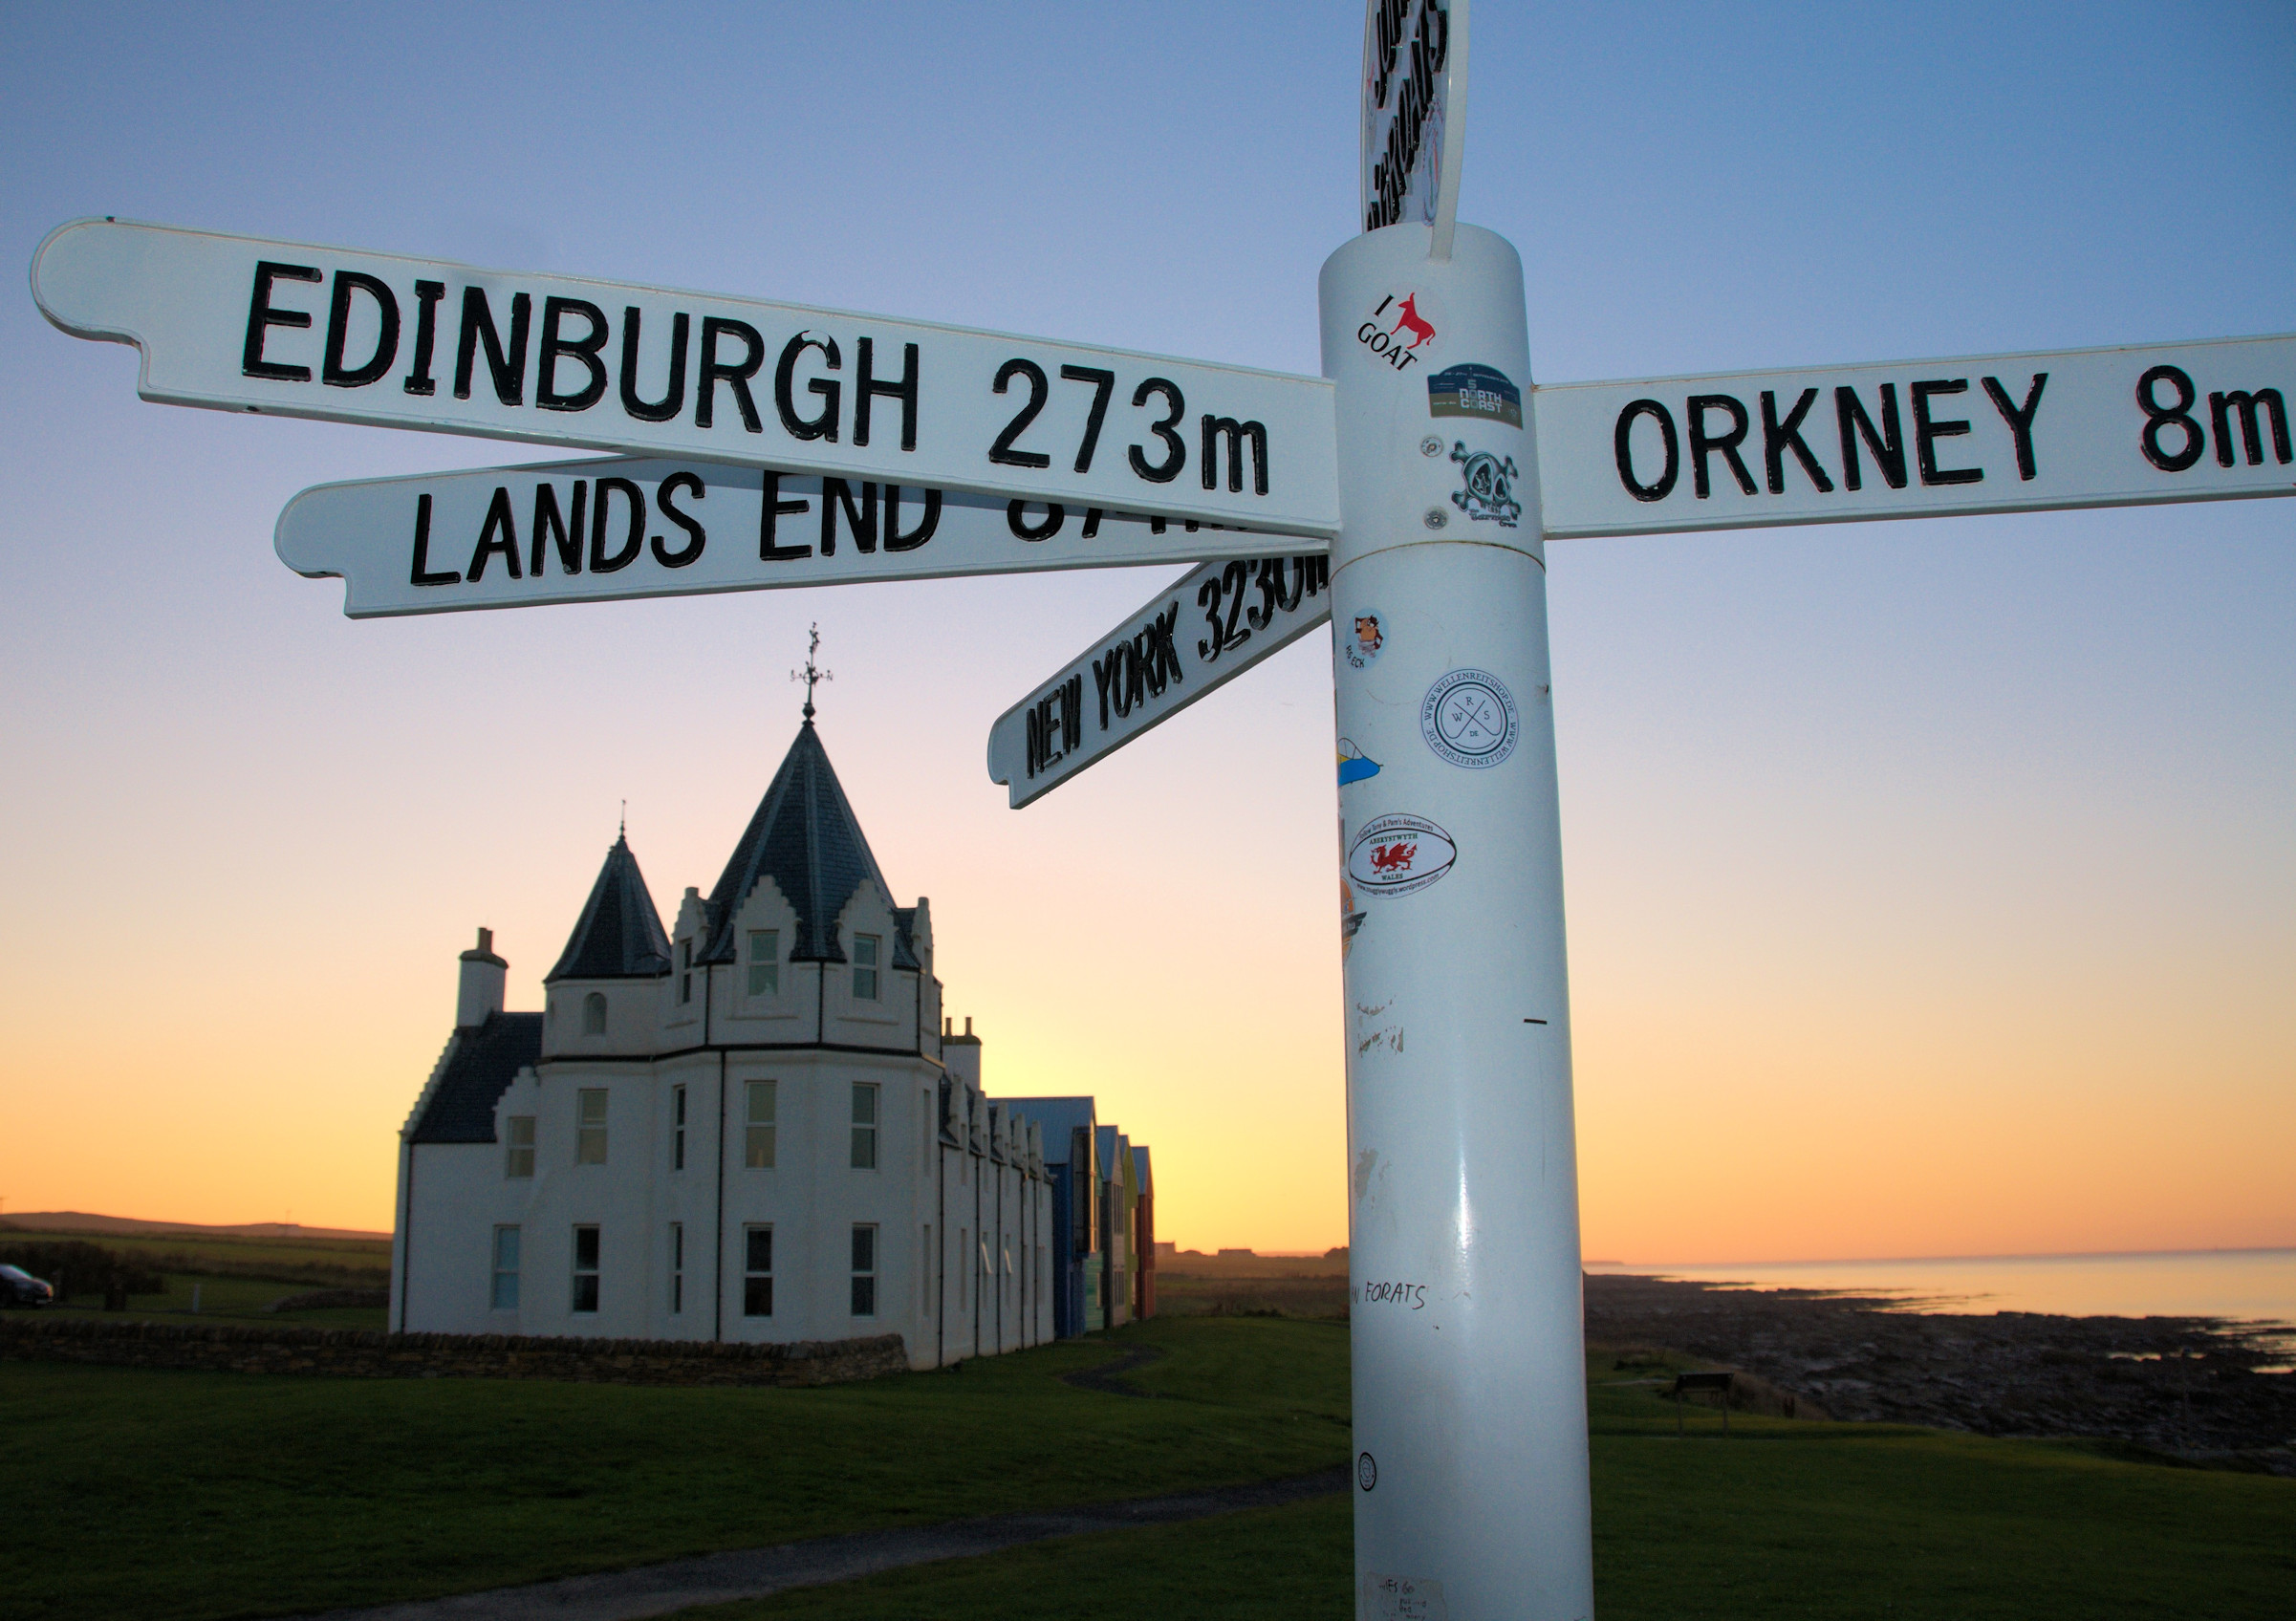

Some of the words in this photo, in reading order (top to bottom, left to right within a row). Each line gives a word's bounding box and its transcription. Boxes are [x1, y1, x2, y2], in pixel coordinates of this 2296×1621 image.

[1374, 293, 1395, 317] I
[1357, 322, 1418, 371] GOAT
[242, 260, 919, 452] EDINBURGH
[988, 358, 1269, 495] 273m
[1459, 388, 1503, 403] NORTH
[1460, 399, 1503, 413] COAST
[1614, 373, 2048, 503] ORKNEY
[2135, 364, 2294, 472] 8m
[410, 471, 705, 586] LANDS
[760, 470, 943, 561] END
[1027, 673, 1081, 779] NEW
[1092, 601, 1182, 731] YORK
[1403, 818, 1434, 832] Adventures
[1369, 832, 1419, 845] ABERYSTWYTH
[1381, 873, 1403, 881] WALES
